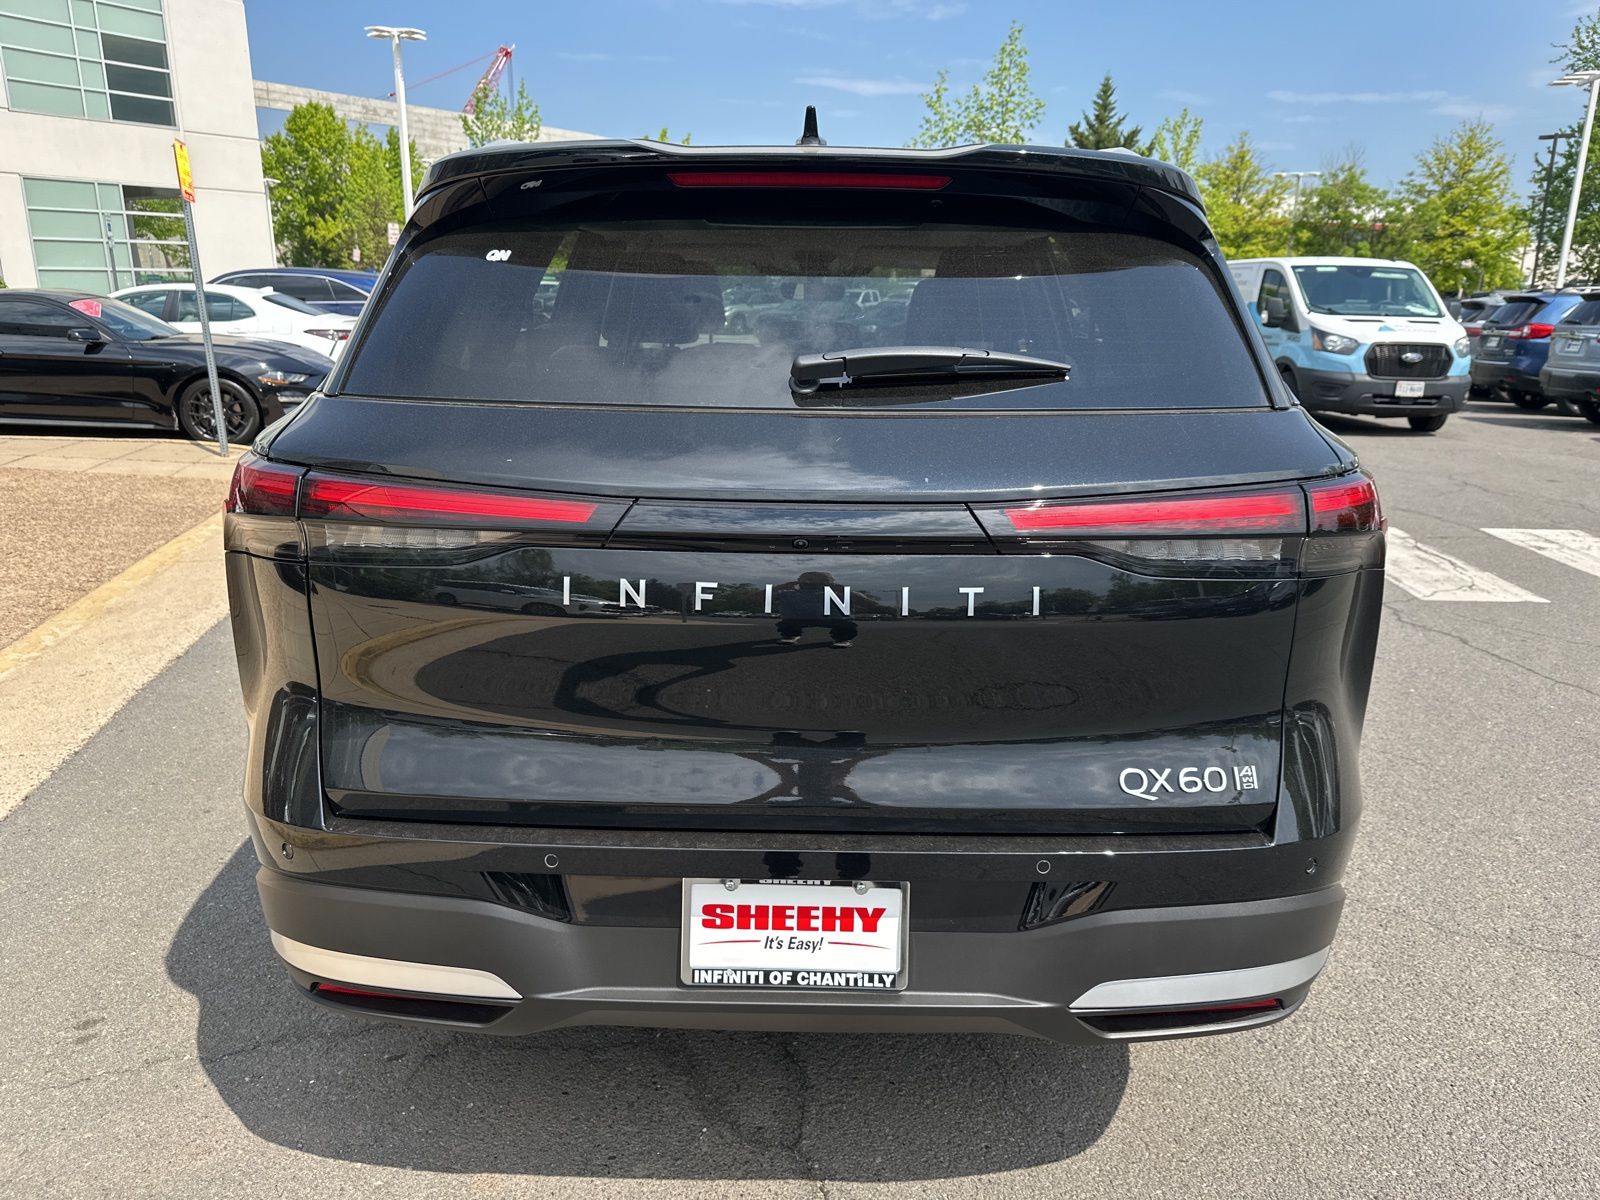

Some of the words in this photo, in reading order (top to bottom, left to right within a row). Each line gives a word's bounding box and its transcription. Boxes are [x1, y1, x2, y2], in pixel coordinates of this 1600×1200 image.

[563, 576, 1041, 617] INFINITI
[1119, 767, 1228, 800] QX60
[701, 904, 886, 932] SHEEHY
[764, 936, 783, 950] It's
[788, 937, 823, 953] Easy!
[694, 969, 764, 984] INFINITI
[769, 971, 792, 985] OF
[796, 972, 895, 987] CHANTILLY
